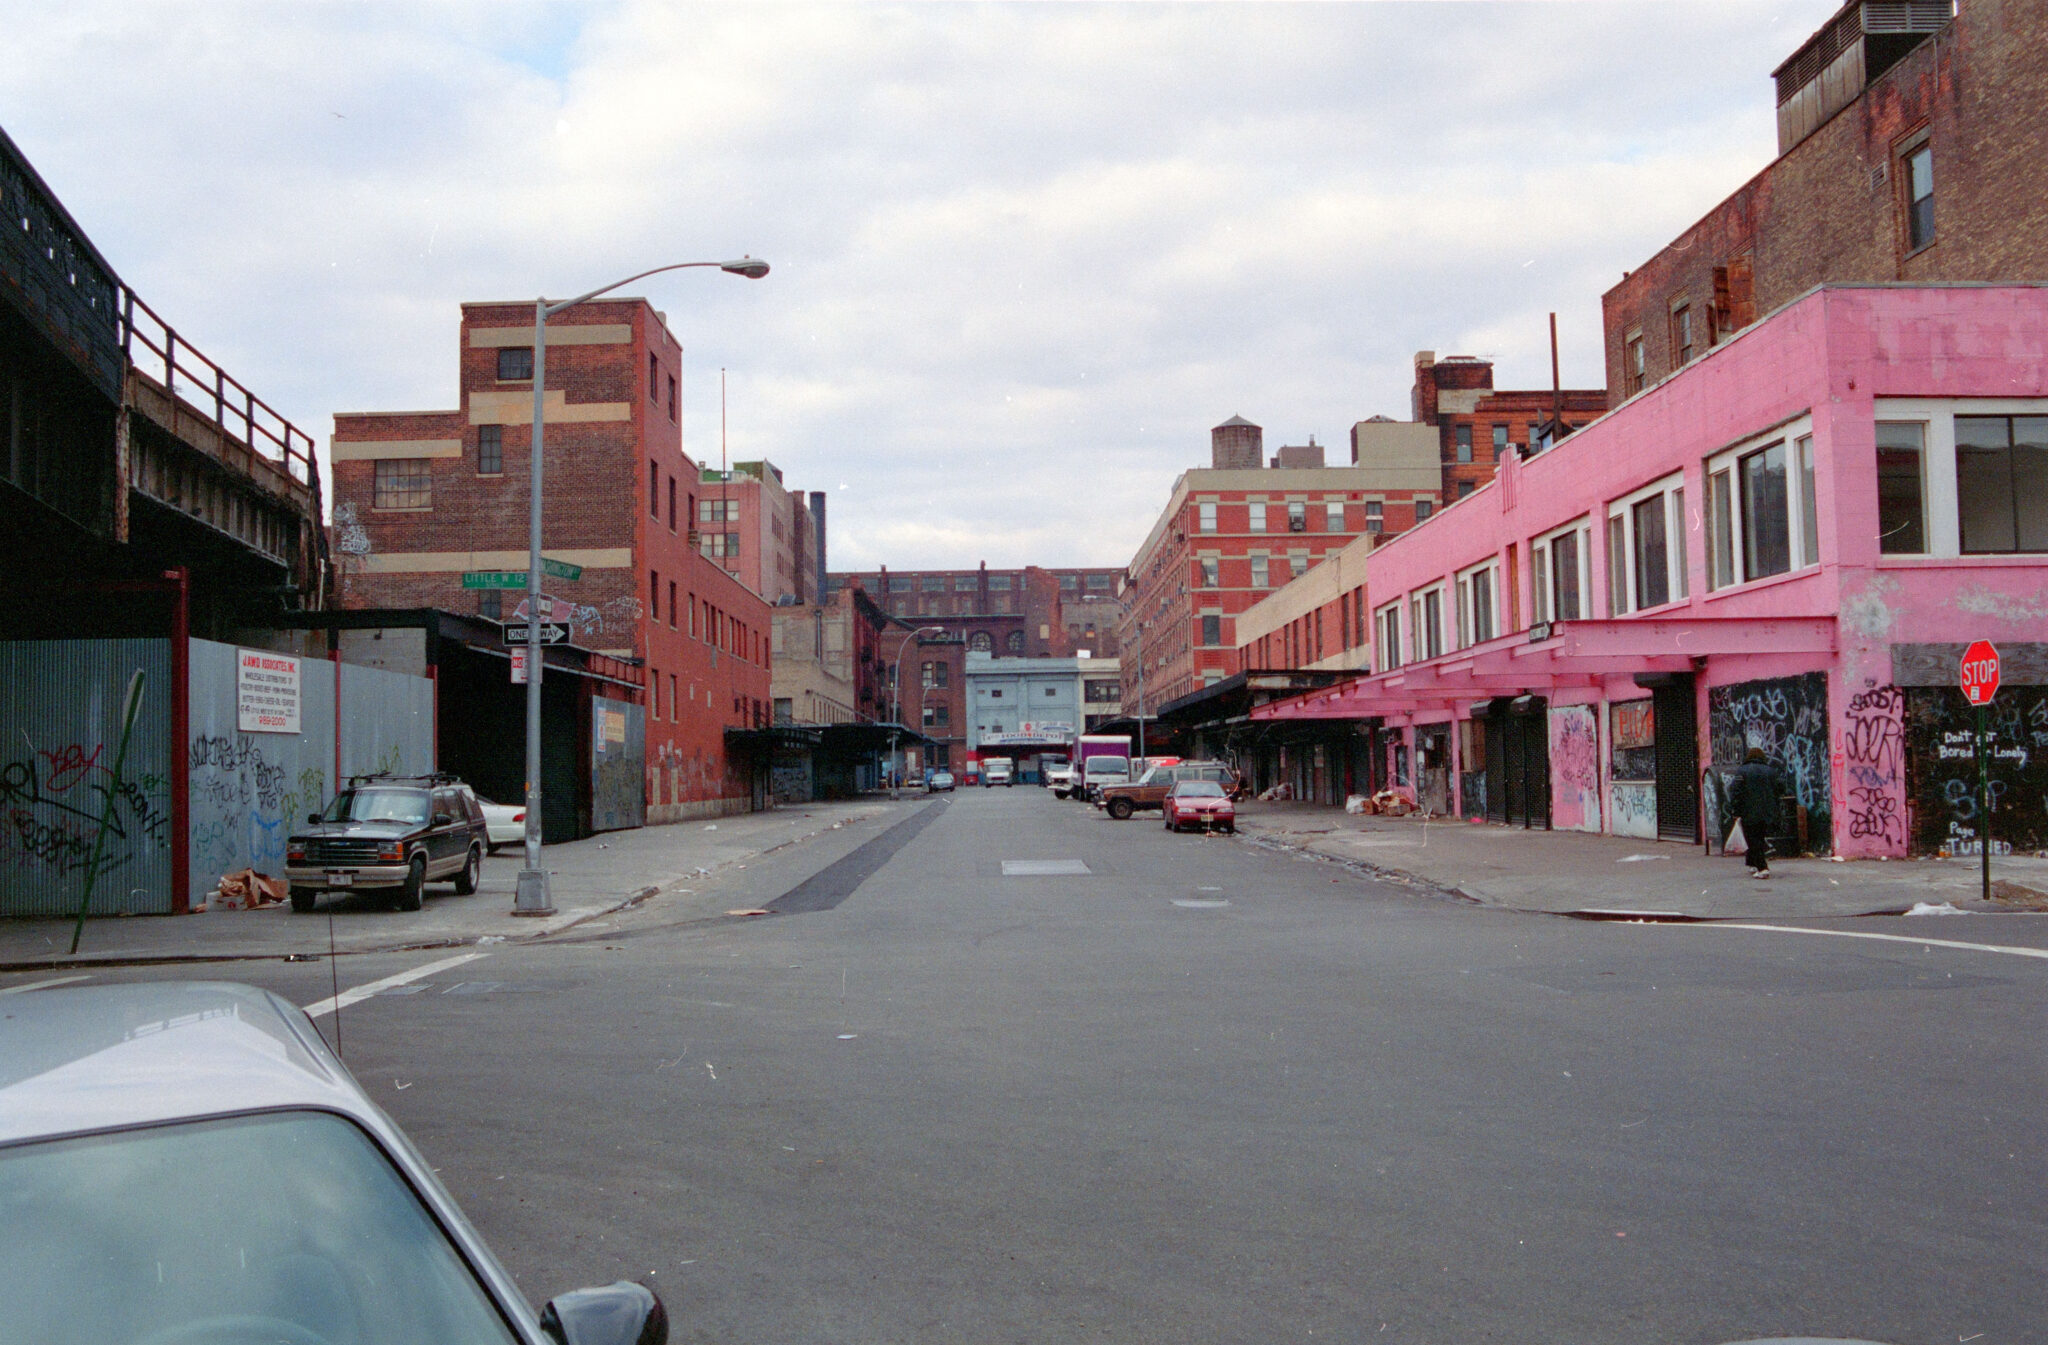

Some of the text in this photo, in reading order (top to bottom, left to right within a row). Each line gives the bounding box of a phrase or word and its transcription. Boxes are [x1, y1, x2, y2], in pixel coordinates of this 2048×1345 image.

[465, 573, 525, 583] LITTLE W 12
[509, 629, 559, 639] ONE WAY
[1963, 659, 1997, 686] STOP
[1938, 745, 1974, 759] Bored
[1994, 745, 2026, 764] Lonely
[1949, 821, 1975, 839] Page
